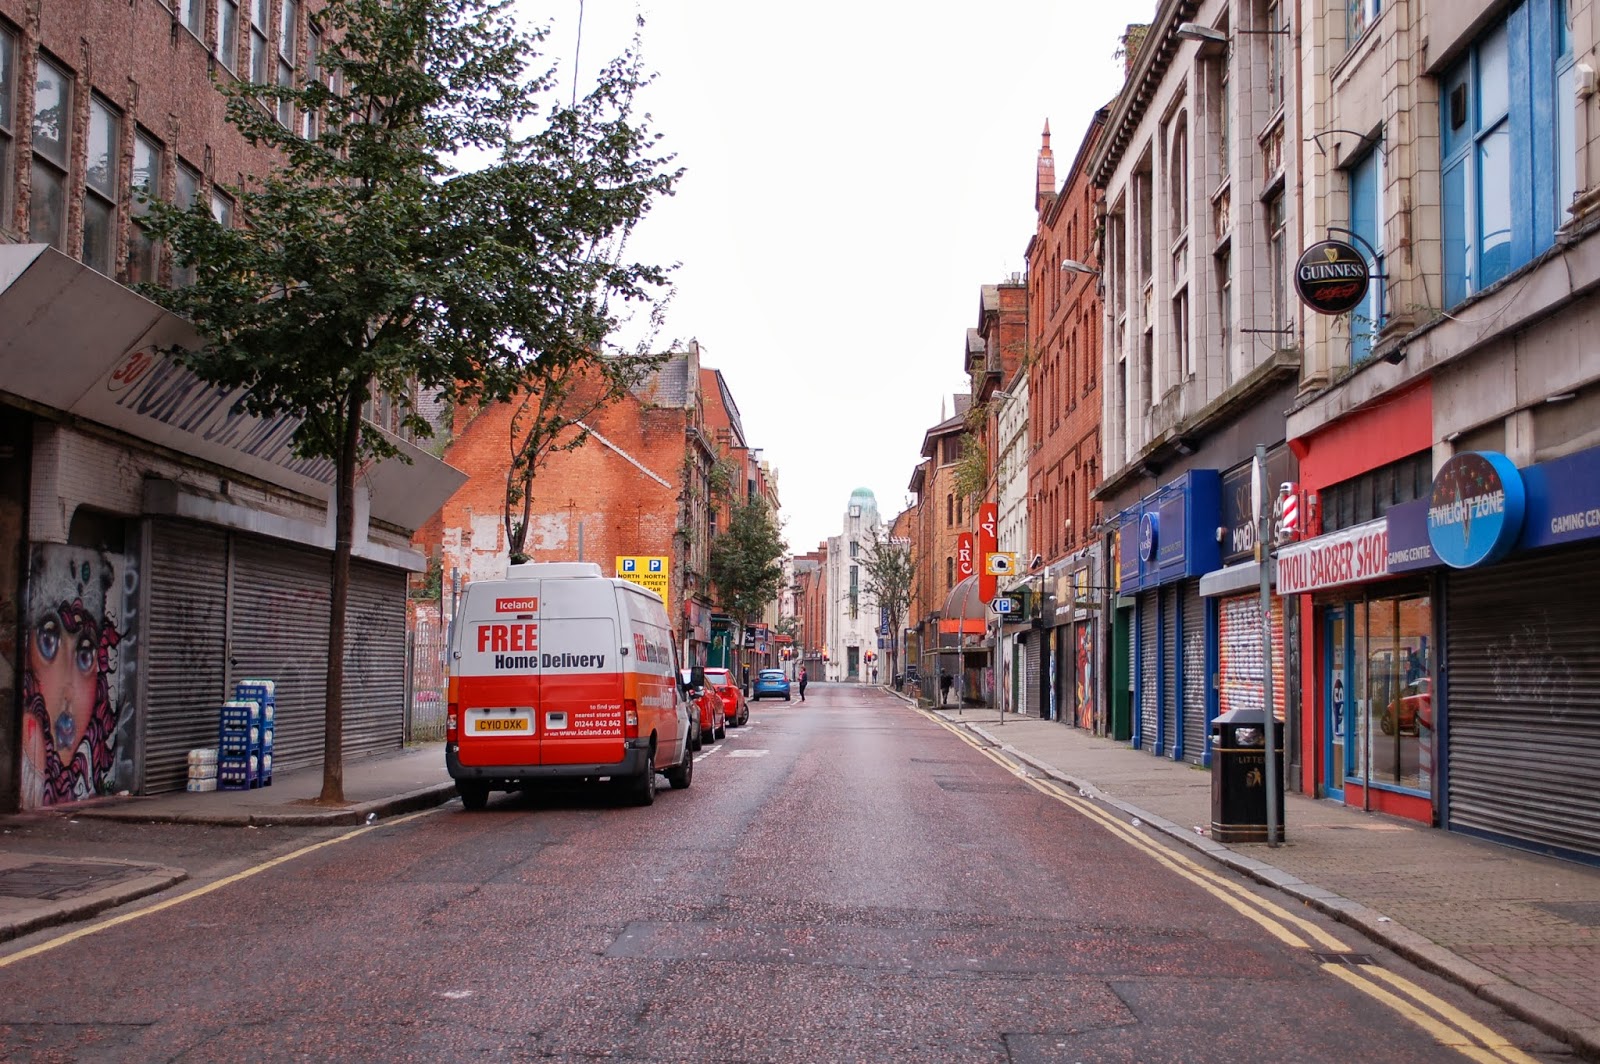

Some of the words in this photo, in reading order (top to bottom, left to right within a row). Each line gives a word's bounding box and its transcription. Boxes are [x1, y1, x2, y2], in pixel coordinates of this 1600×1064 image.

[1300, 264, 1364, 280] GUINNESS
[113, 352, 152, 384] 30
[1428, 499, 1473, 528] TWILIGHT
[1475, 489, 1505, 518] ZONE
[1551, 512, 1584, 534] GAMING
[1388, 549, 1408, 565] GAMING
[1409, 545, 1431, 561] CENTRE
[1279, 553, 1307, 592] TIVOLI
[1310, 541, 1354, 587] BARBER
[499, 600, 534, 610] Iceland
[1000, 601, 1009, 611] P
[477, 623, 538, 652] FREE
[495, 654, 538, 669] Home
[541, 652, 605, 668] Delivery
[560, 728, 621, 736] www.iceland.co.uk
[1238, 756, 1265, 764] LITTE
